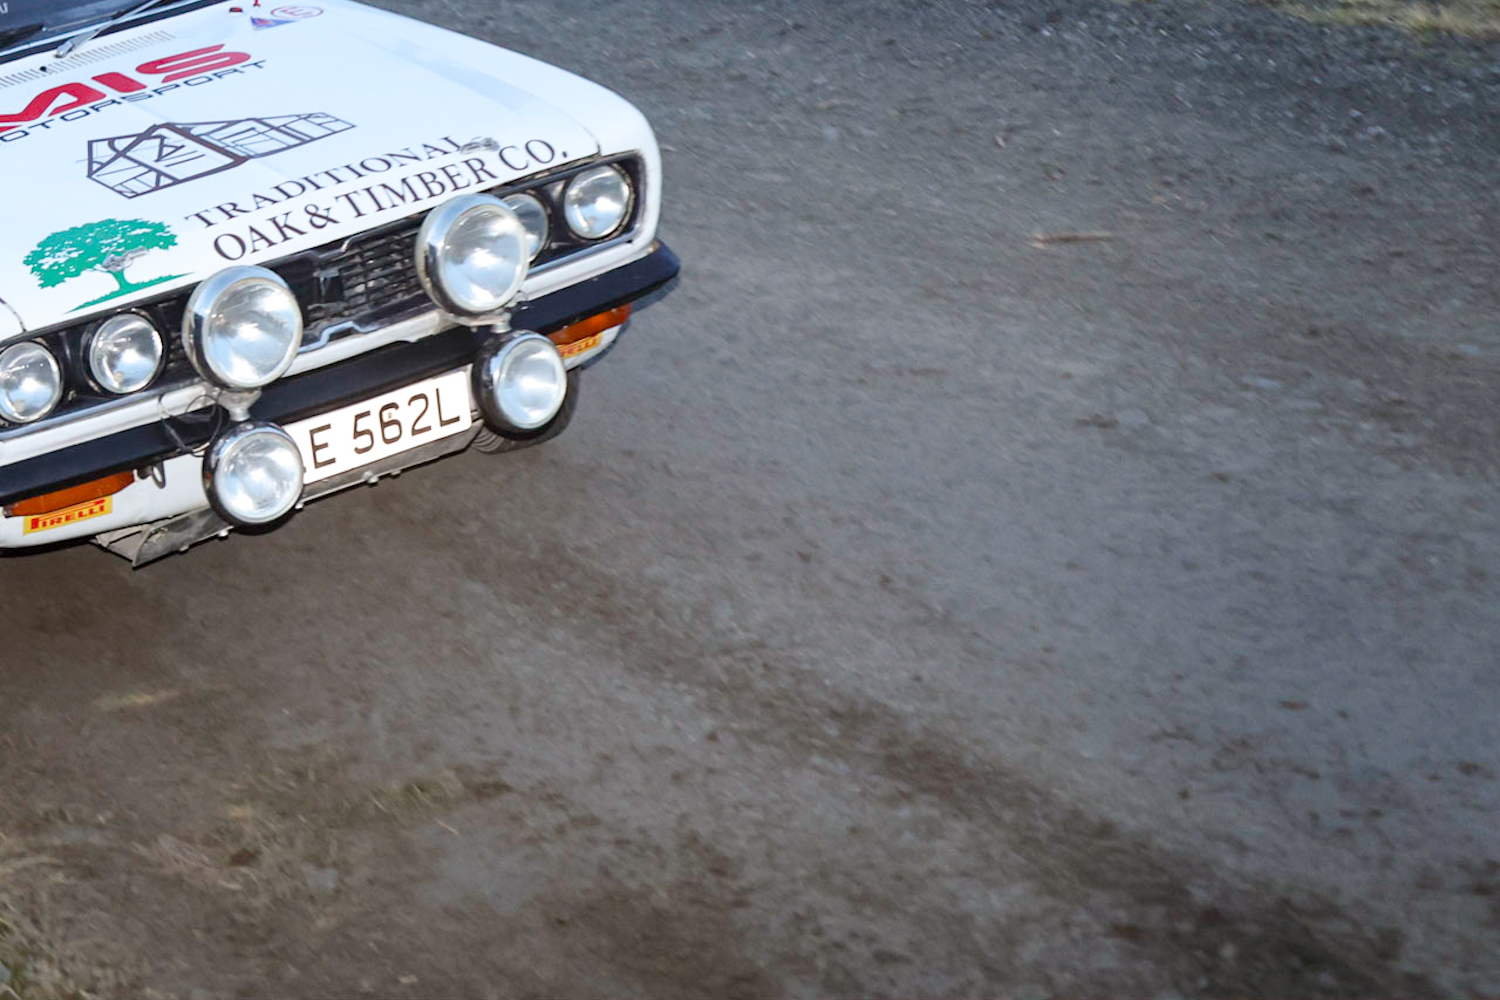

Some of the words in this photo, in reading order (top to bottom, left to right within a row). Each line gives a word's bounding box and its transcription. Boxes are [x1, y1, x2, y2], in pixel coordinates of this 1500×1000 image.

[499, 138, 568, 172] CO.
[184, 136, 463, 229] TRADITIONAL
[353, 388, 460, 454] 562L
[31, 499, 105, 530] PIRELLI
